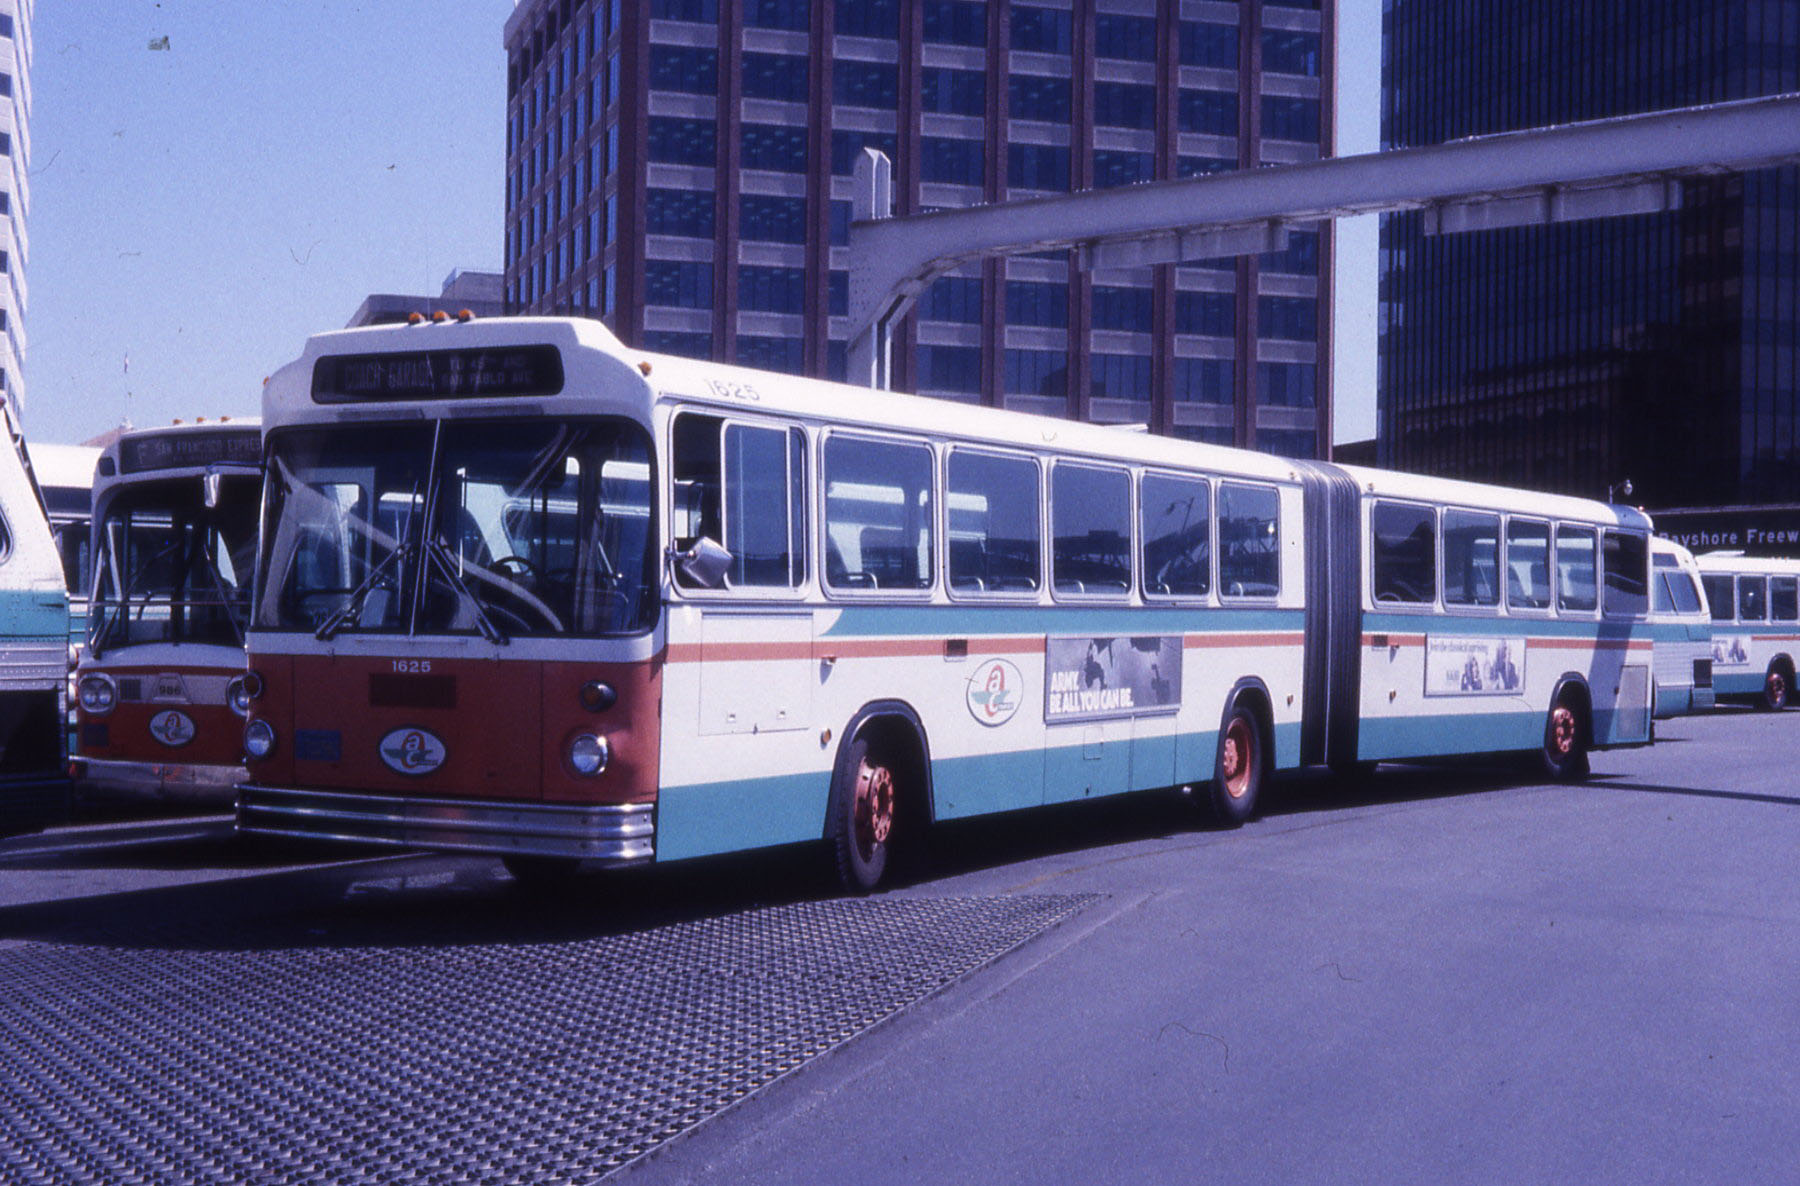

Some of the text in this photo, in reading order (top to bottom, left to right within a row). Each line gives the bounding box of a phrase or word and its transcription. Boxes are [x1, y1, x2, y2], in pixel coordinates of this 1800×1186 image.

[704, 378, 760, 401] 1625
[1747, 529, 1799, 544] Freew
[392, 660, 431, 673] 1625
[159, 685, 181, 695] 986
[1049, 693, 1062, 714] BE
[1063, 691, 1080, 713] ALL
[1080, 690, 1099, 712] YOU
[1100, 688, 1119, 710] CAN
